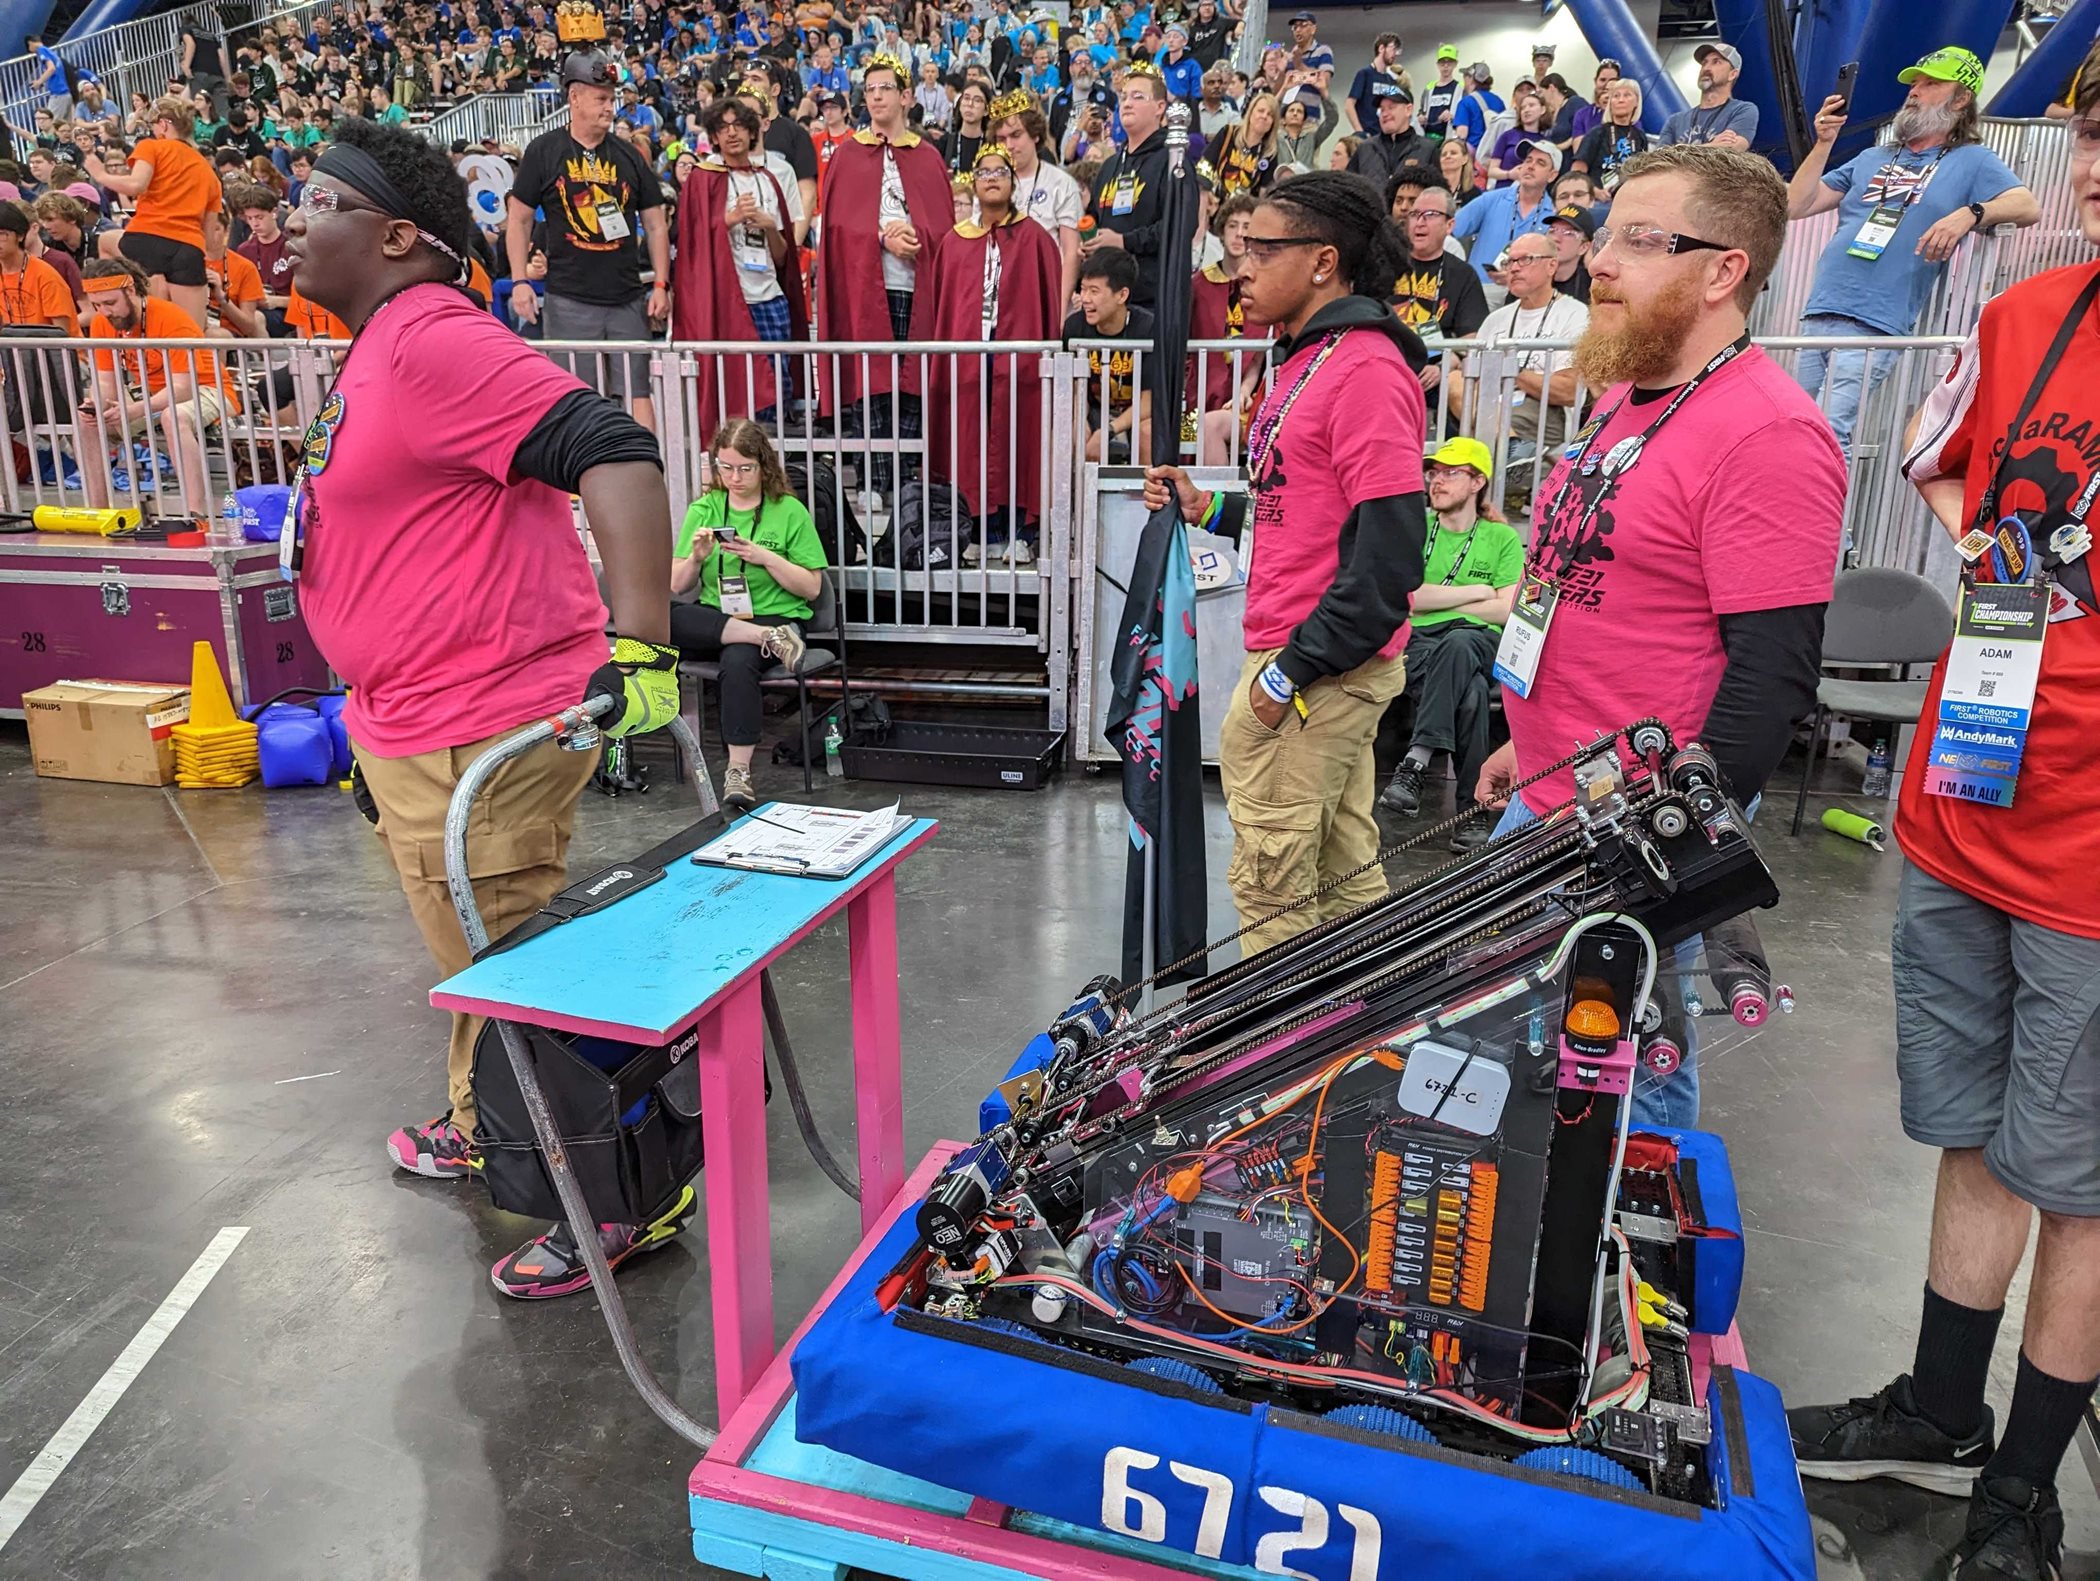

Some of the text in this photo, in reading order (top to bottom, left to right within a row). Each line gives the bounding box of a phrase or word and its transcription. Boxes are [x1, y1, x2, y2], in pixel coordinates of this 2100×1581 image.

[1467, 570, 1492, 580] FIRST
[1974, 609, 2034, 622] CHAMPIONSHIP
[1515, 625, 1531, 641] RUFUS
[22, 631, 46, 652] 28
[276, 641, 294, 663] 28
[1979, 647, 2013, 660] ADAM
[30, 702, 62, 712] PHILIPS
[1978, 707, 2019, 719] ROBOTICS
[1957, 711, 2009, 725] COMPETITION
[1954, 729, 2016, 744] AndyMark
[1001, 772, 1021, 780] ULINE
[1938, 780, 2002, 803] I'M AN ALLY
[1573, 1043, 1607, 1054] Allen-Bradley
[1425, 1079, 1477, 1104] 6721-C
[935, 1226, 962, 1244] NEO
[1101, 1446, 1381, 1581] 6721
